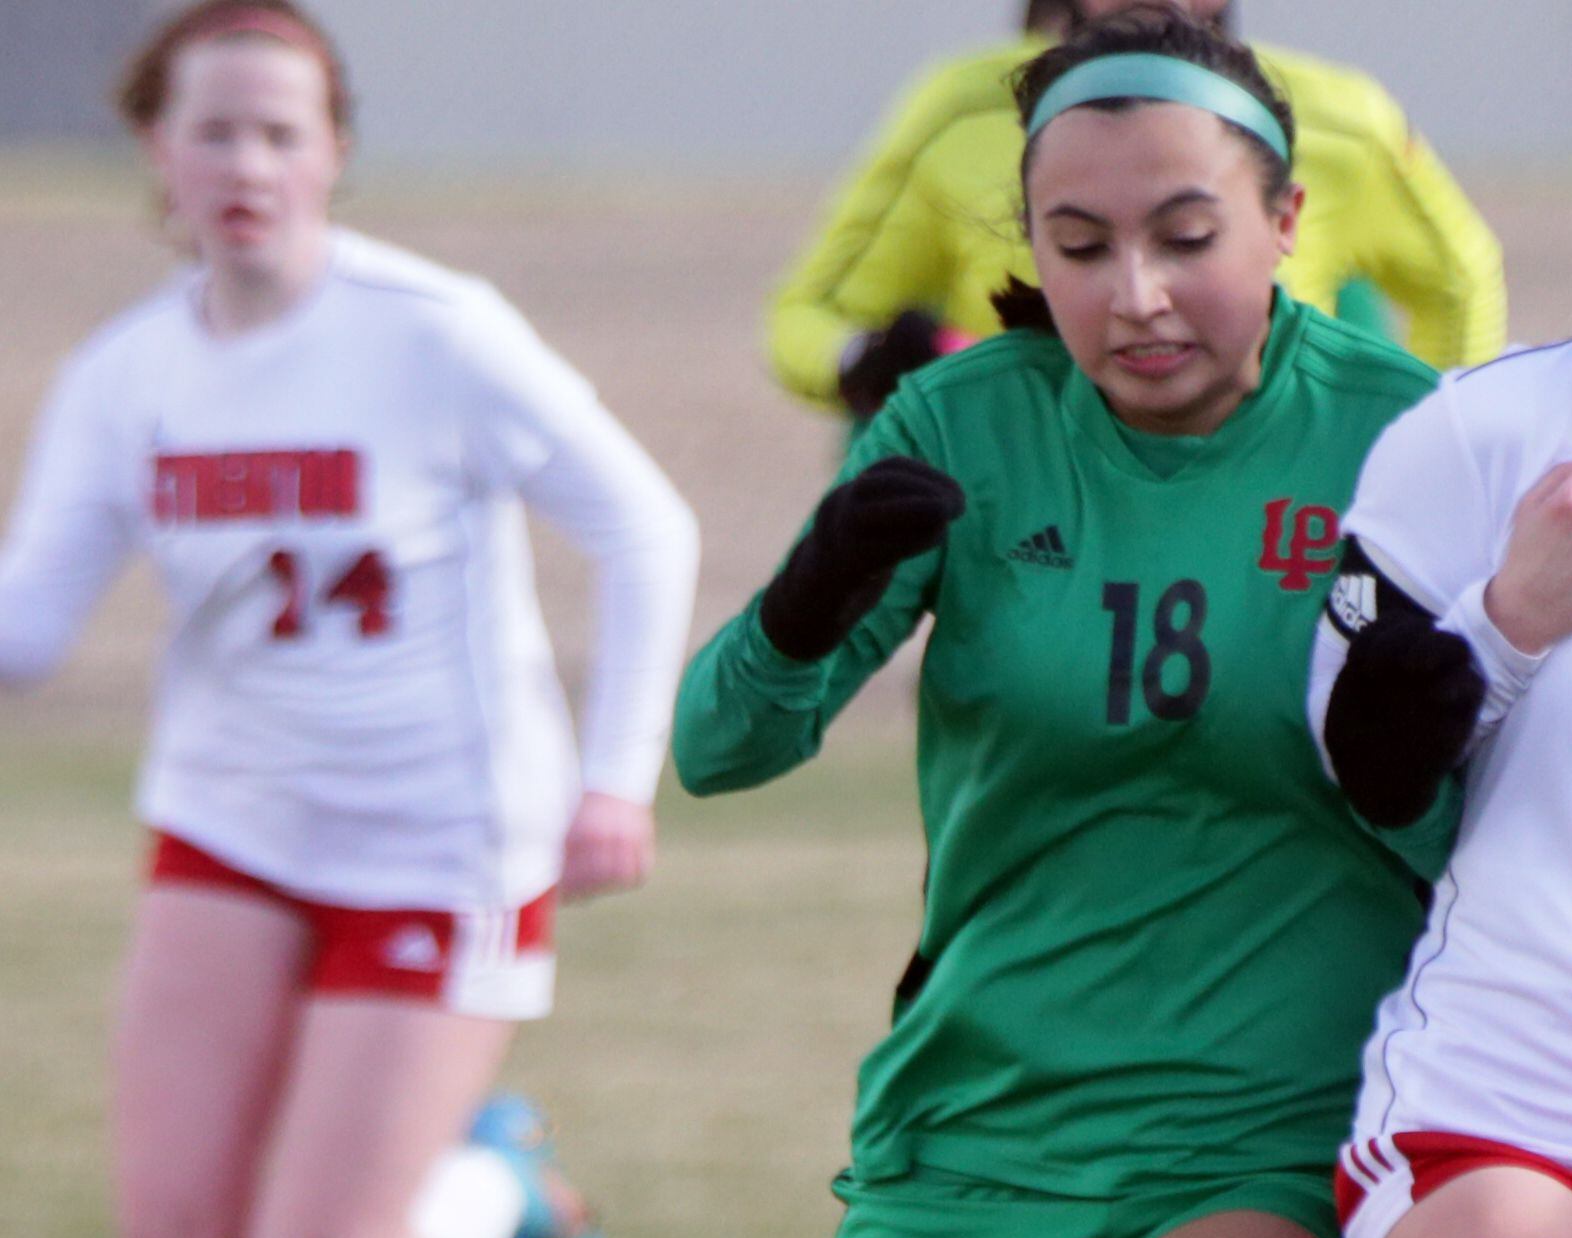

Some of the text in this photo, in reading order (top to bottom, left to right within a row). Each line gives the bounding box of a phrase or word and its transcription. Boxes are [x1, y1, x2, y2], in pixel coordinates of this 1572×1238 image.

[1008, 548, 1076, 572] adidas
[1258, 498, 1339, 591] LP
[268, 550, 392, 639] 14
[1102, 579, 1211, 726] 18
